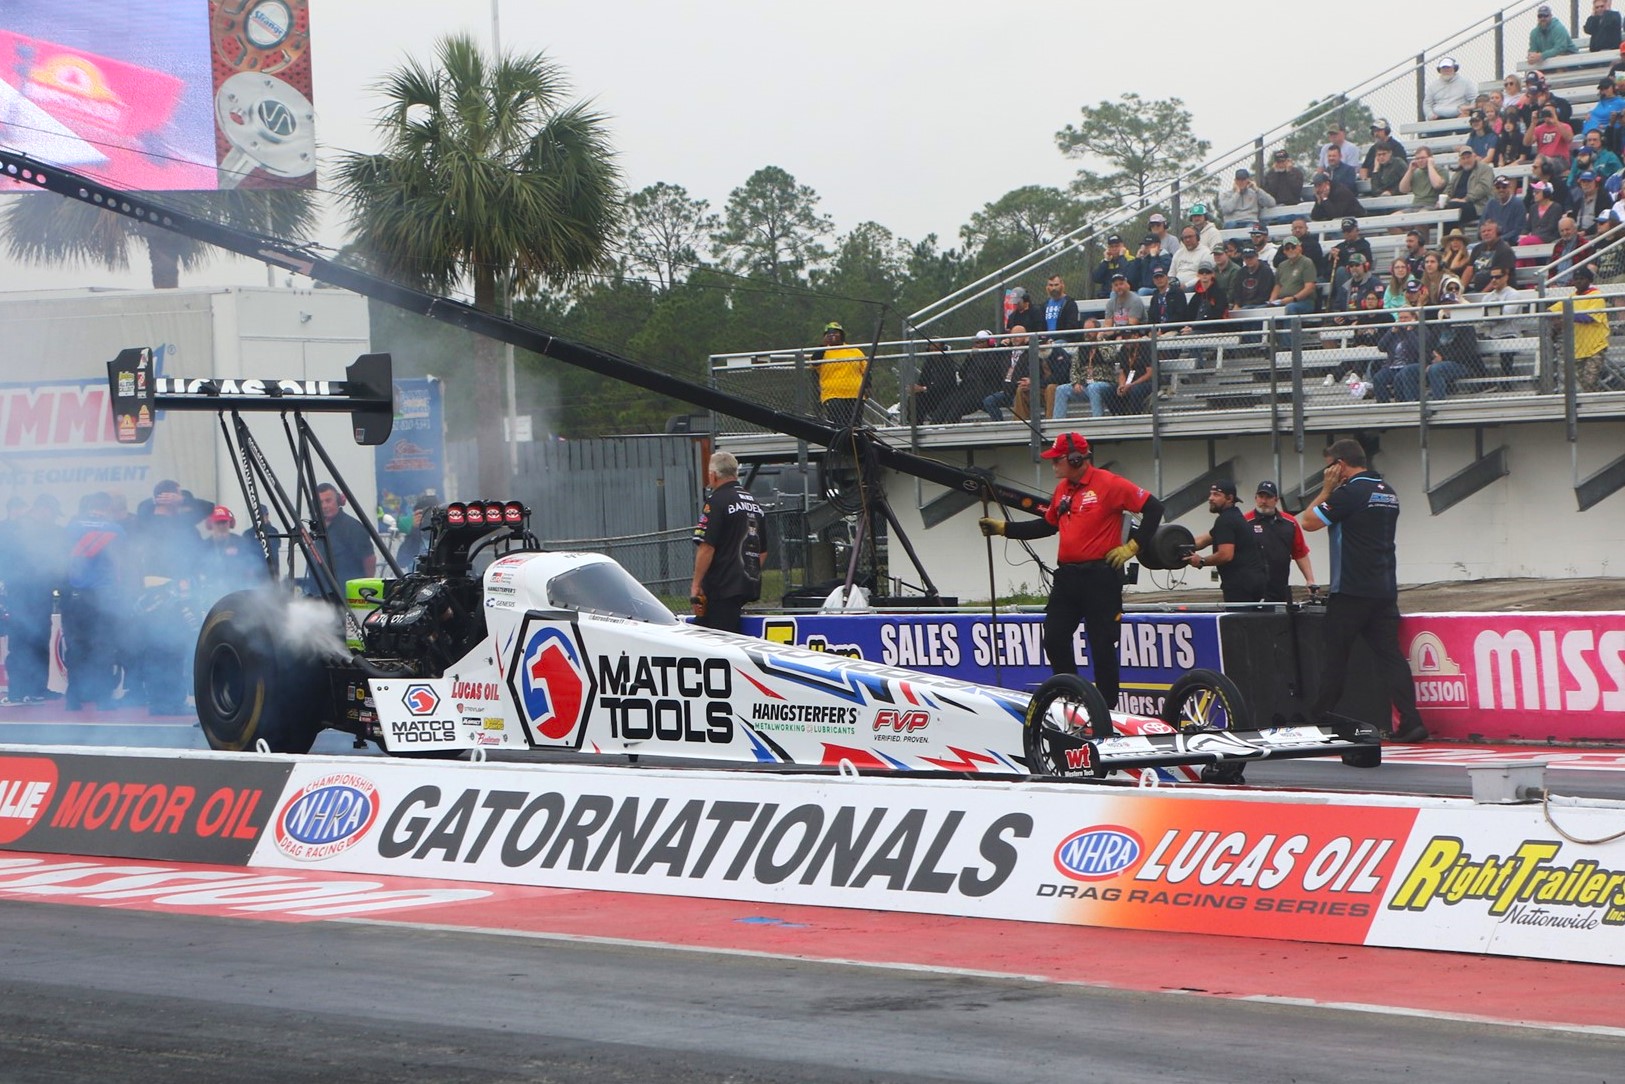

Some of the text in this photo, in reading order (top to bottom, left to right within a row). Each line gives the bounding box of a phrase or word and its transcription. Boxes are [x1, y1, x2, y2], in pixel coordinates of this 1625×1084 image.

[32, 464, 149, 484] EQUIPMENT
[880, 623, 960, 667] SALES
[972, 623, 1089, 667] SERVE
[1113, 623, 1196, 669] ARTS
[599, 655, 732, 699] MATCO
[451, 682, 500, 701] LUCAS OIL
[1415, 680, 1466, 702] ISSION
[600, 697, 734, 744] TOOLS
[752, 703, 858, 724] HANGSTERFER'S
[873, 710, 930, 732] FVP
[392, 721, 455, 731] MATCO
[392, 731, 456, 742] TOOLS
[754, 722, 855, 735] METALWORKING LUBRICANTS
[902, 735, 930, 743] PROVEN.
[305, 774, 374, 793] CHAMPIONSHIP
[50, 781, 263, 839] MOTOR OIL
[289, 790, 364, 839] NHRA
[280, 836, 346, 857] DRAG RACING
[376, 783, 1035, 897] GATORNATIONALS
[1068, 833, 1130, 874] NHRA
[1135, 829, 1395, 893] LUCAS OIL
[1036, 884, 1371, 918] DRAG RACING SERIES
[1499, 905, 1600, 930] Nationwide
